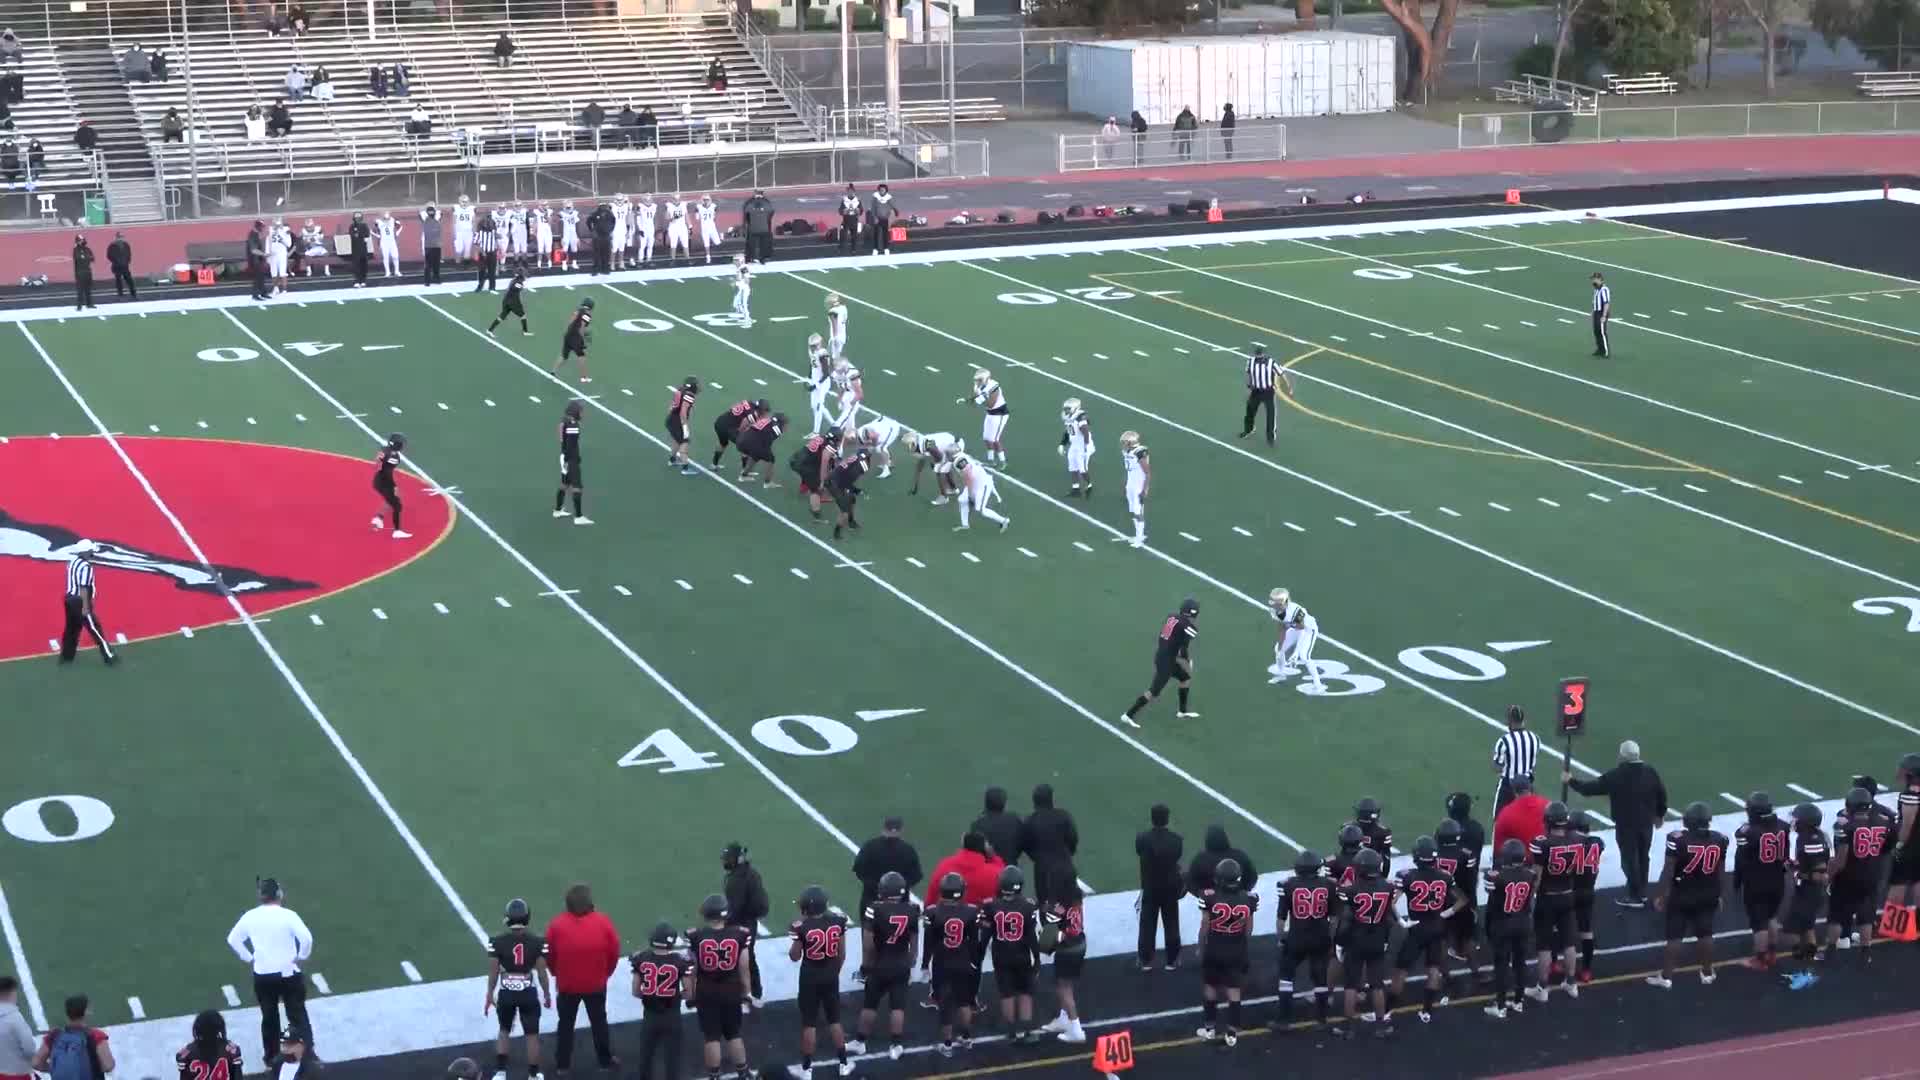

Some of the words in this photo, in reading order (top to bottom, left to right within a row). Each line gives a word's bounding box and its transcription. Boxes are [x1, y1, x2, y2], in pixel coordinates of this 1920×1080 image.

[1563, 683, 1585, 715] 3
[1759, 830, 1786, 863] 61
[1853, 826, 1888, 859] 65
[1684, 845, 1721, 875] 70
[1292, 887, 1329, 919] 66
[1353, 892, 1390, 924] 27
[1409, 879, 1447, 912] 23
[1504, 881, 1531, 913] 18
[887, 915, 909, 944] 7
[944, 918, 964, 948] 9
[994, 911, 1024, 942] 13
[1211, 903, 1250, 934] 22
[1883, 905, 1909, 934] 30
[512, 943, 524, 966] 1
[700, 938, 739, 971] 63
[806, 925, 842, 960] 26
[640, 962, 679, 997] 32
[1105, 1035, 1131, 1064] 40
